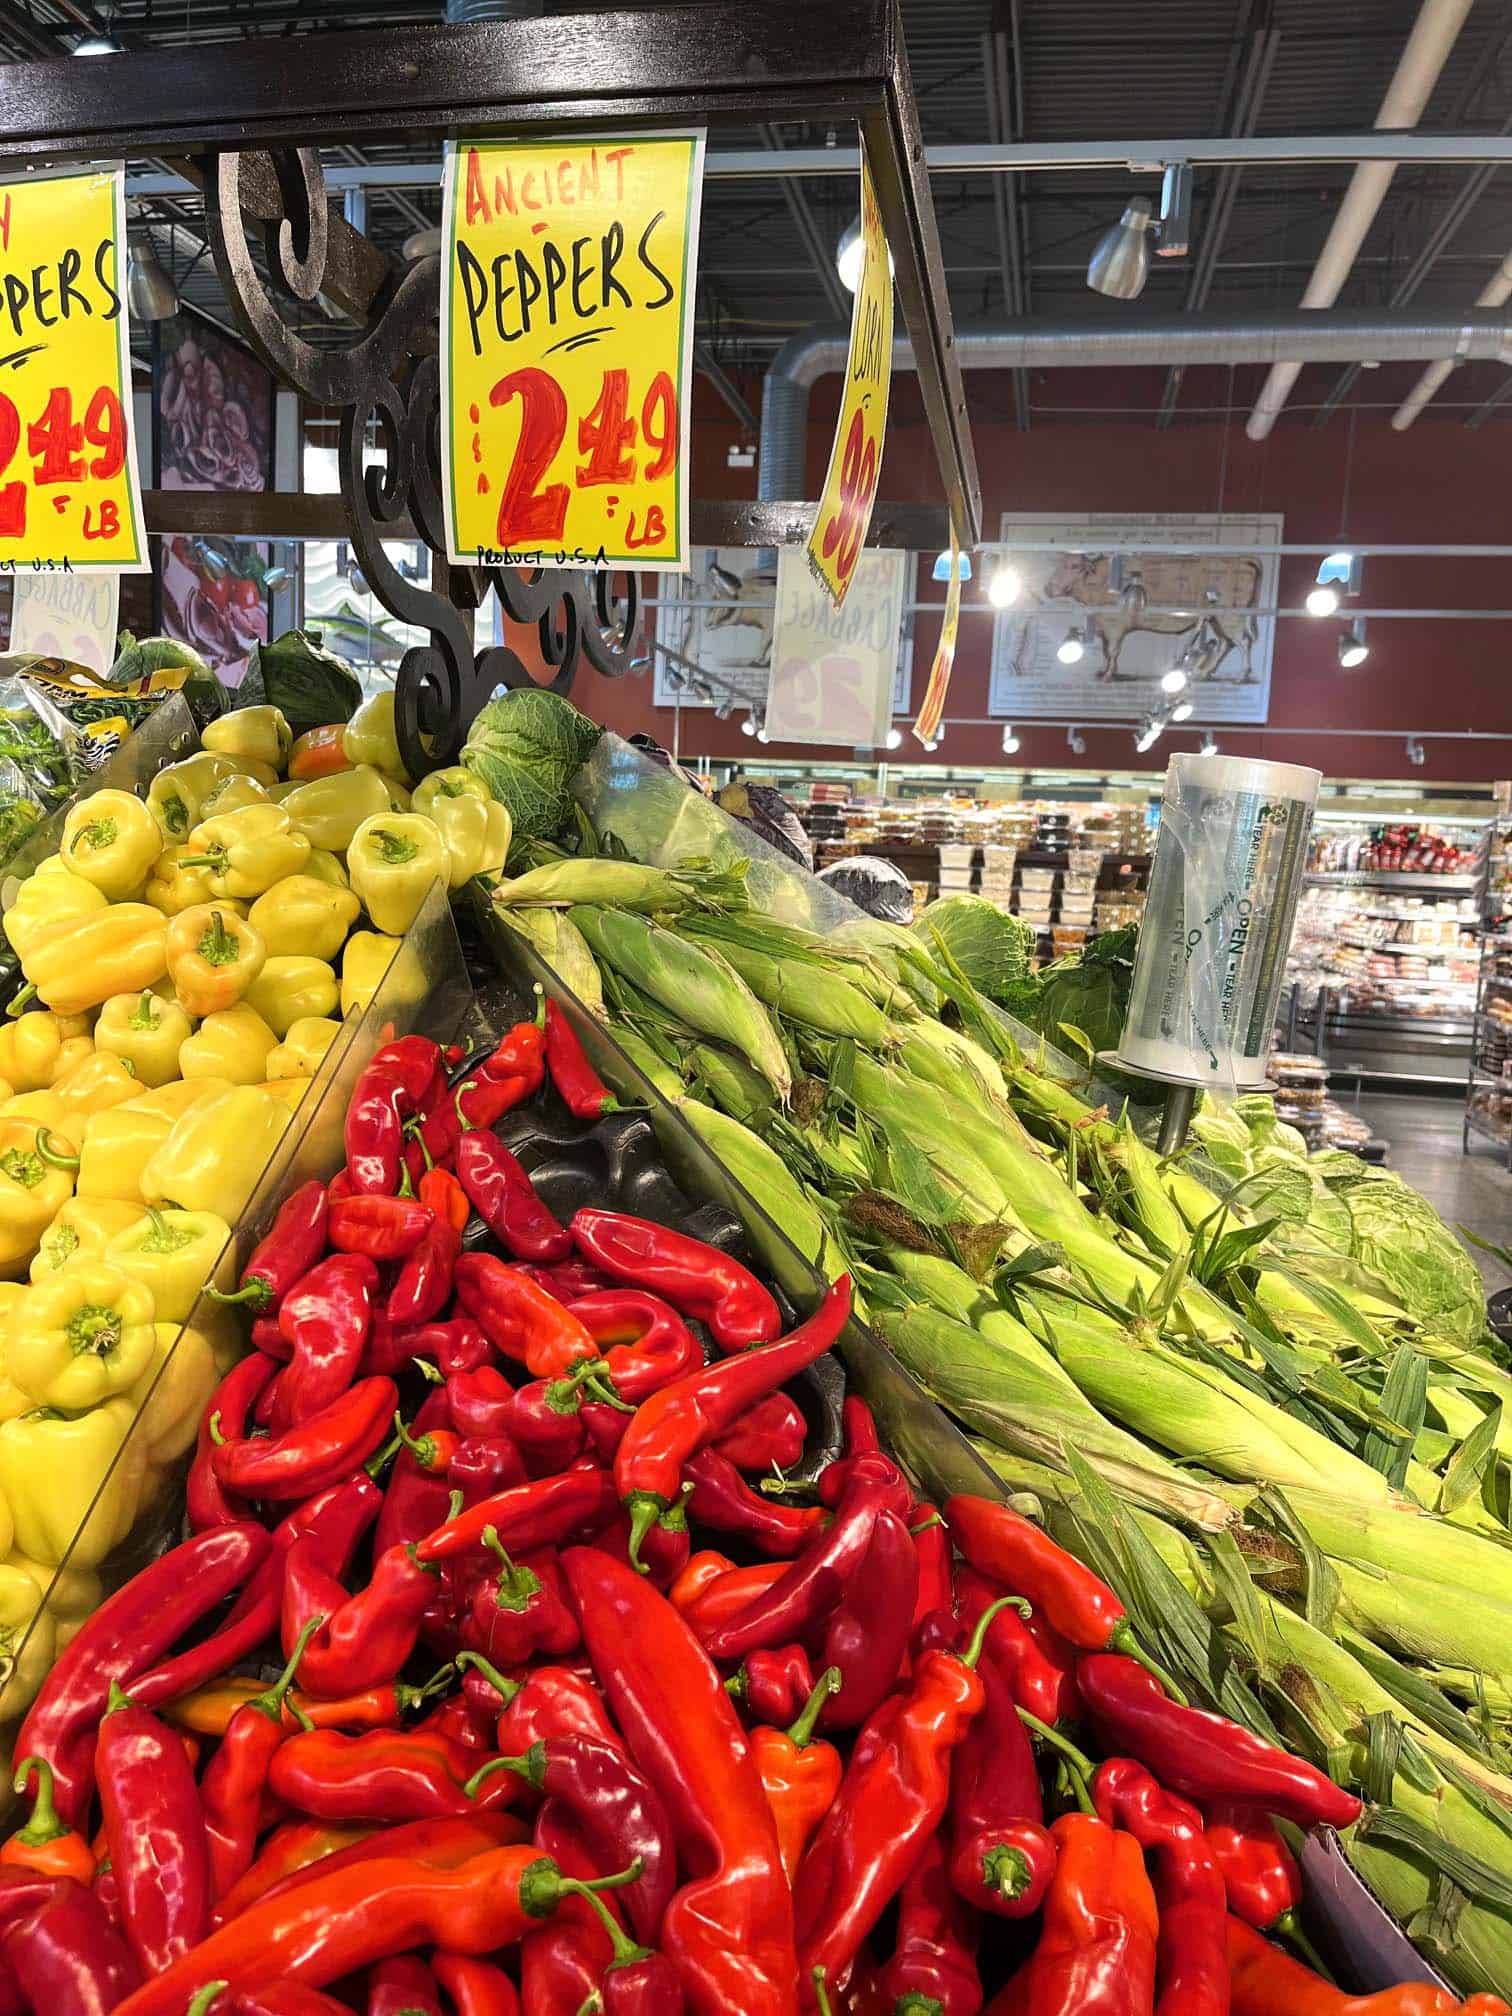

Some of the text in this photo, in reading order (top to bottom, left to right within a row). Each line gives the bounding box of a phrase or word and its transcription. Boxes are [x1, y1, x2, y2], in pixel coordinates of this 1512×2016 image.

[465, 146, 635, 225] ANCIENT
[456, 211, 674, 356] PEPPERS
[83, 499, 120, 540] LB
[625, 504, 667, 549] LB
[477, 545, 543, 566] PRODUCT
[1249, 823, 1264, 850] TEAR
[1245, 853, 1258, 880] HERE
[1228, 899, 1252, 954] OPEN
[1222, 974, 1236, 1003] TEAR
